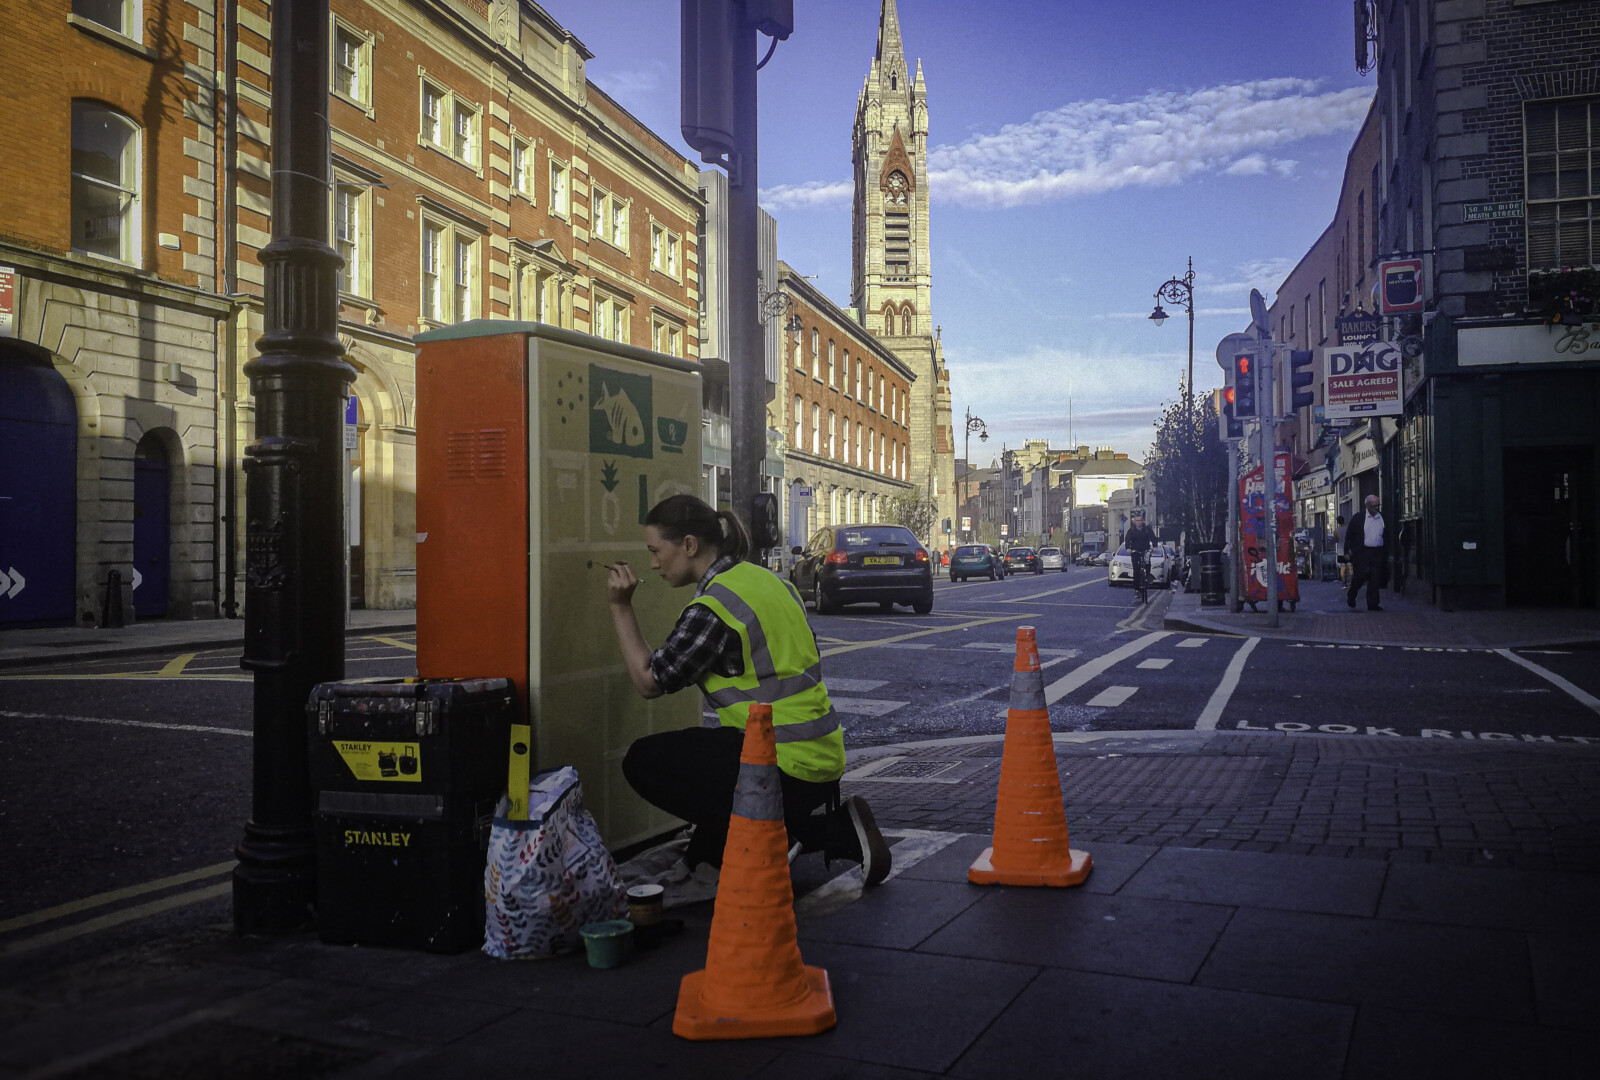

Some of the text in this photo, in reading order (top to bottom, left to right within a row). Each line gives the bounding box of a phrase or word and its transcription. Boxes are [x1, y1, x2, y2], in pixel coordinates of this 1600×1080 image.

[1492, 209, 1521, 218] STREET
[1341, 320, 1377, 334] BAKERS
[1331, 348, 1398, 375] DNG
[1333, 377, 1394, 388] SALE AGREED
[1236, 720, 1600, 744] LOOK RIGHT
[341, 743, 372, 751] STANLEY
[344, 830, 411, 847] STANLEY
